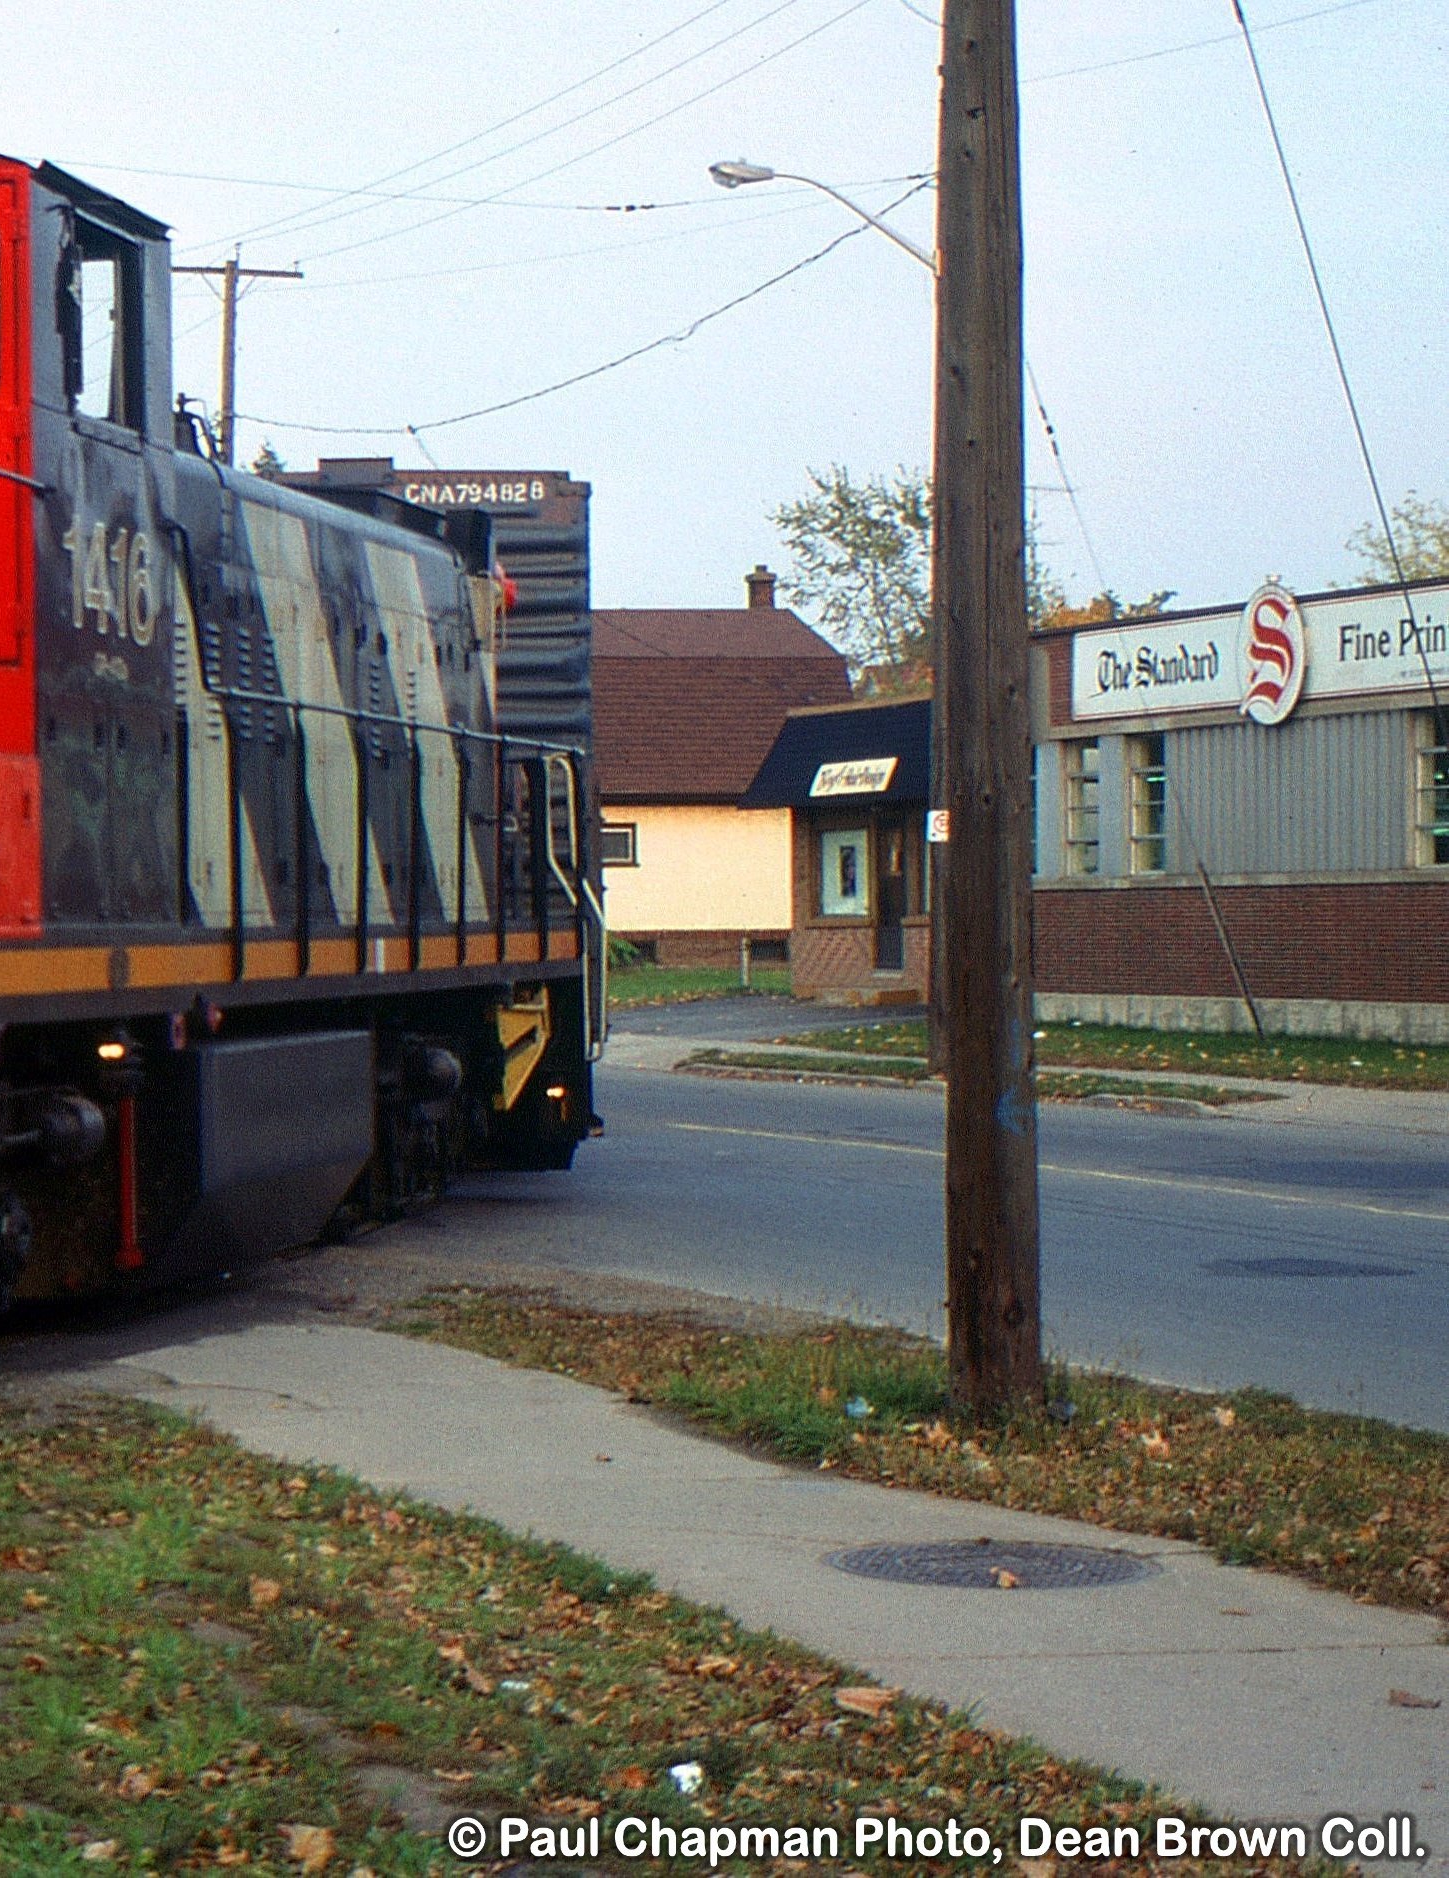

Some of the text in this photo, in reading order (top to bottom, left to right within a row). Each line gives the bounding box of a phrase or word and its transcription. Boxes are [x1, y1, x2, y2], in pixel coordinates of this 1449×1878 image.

[62, 514, 161, 647] 1416
[1091, 640, 1220, 697] The Standard
[1339, 624, 1391, 662] Fine
